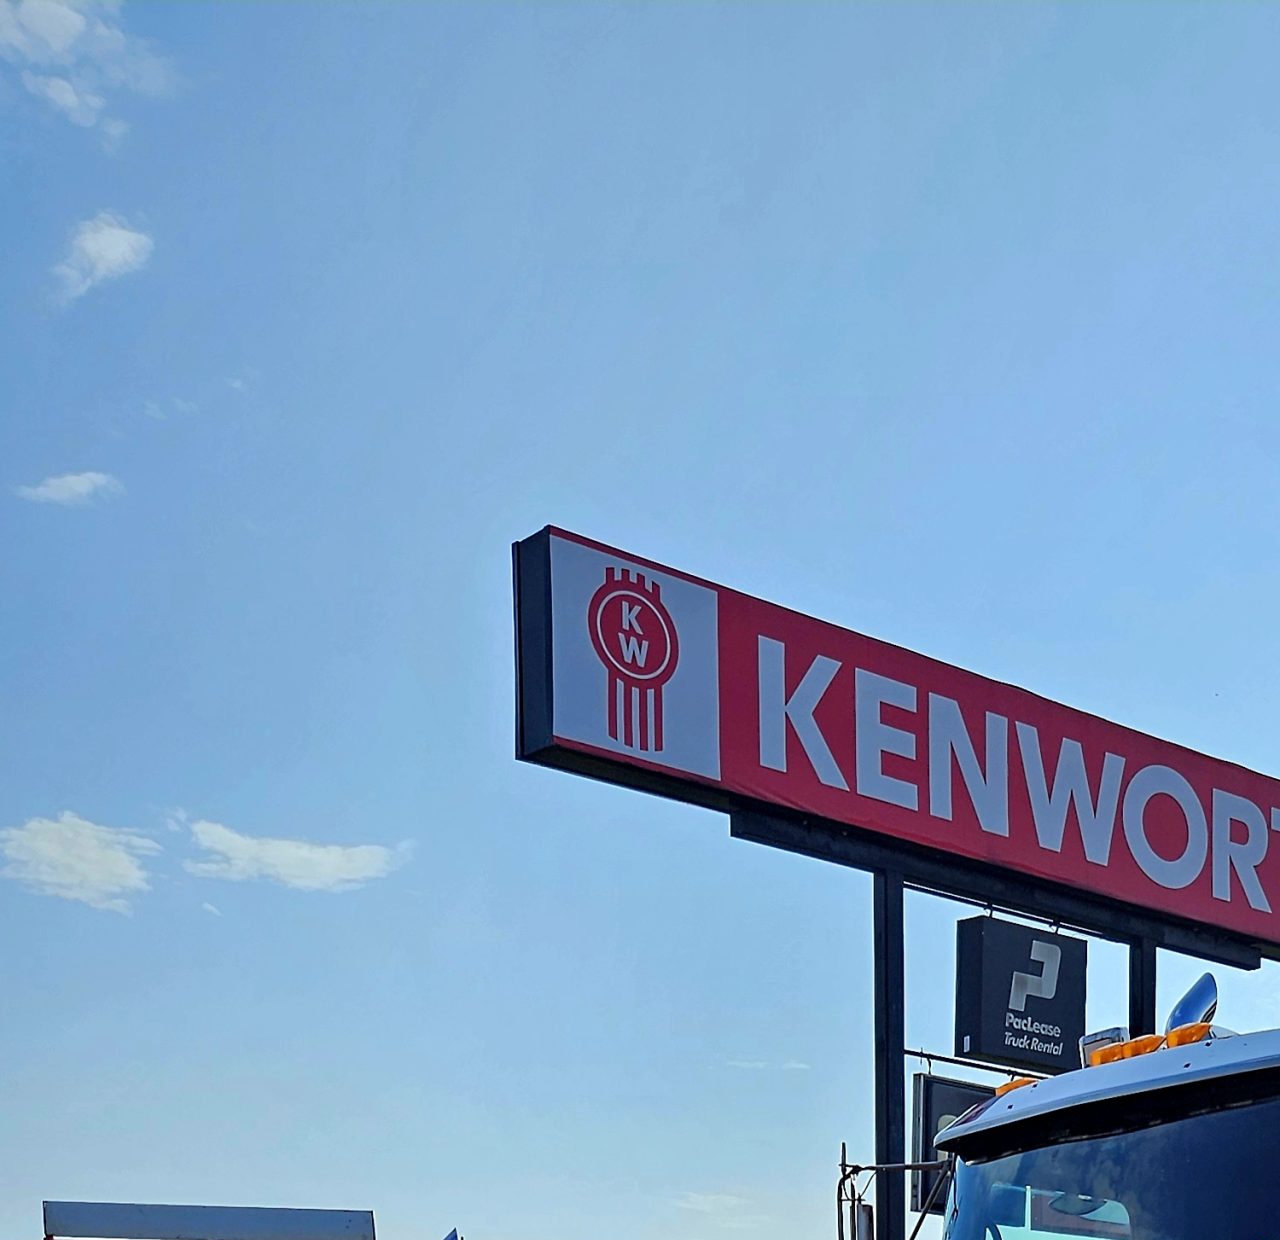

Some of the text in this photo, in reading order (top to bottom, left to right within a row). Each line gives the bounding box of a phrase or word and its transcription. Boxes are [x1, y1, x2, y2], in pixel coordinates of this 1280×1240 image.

[1005, 1012, 1061, 1037] PacLease
[1004, 1031, 1064, 1056] Truck Rental
